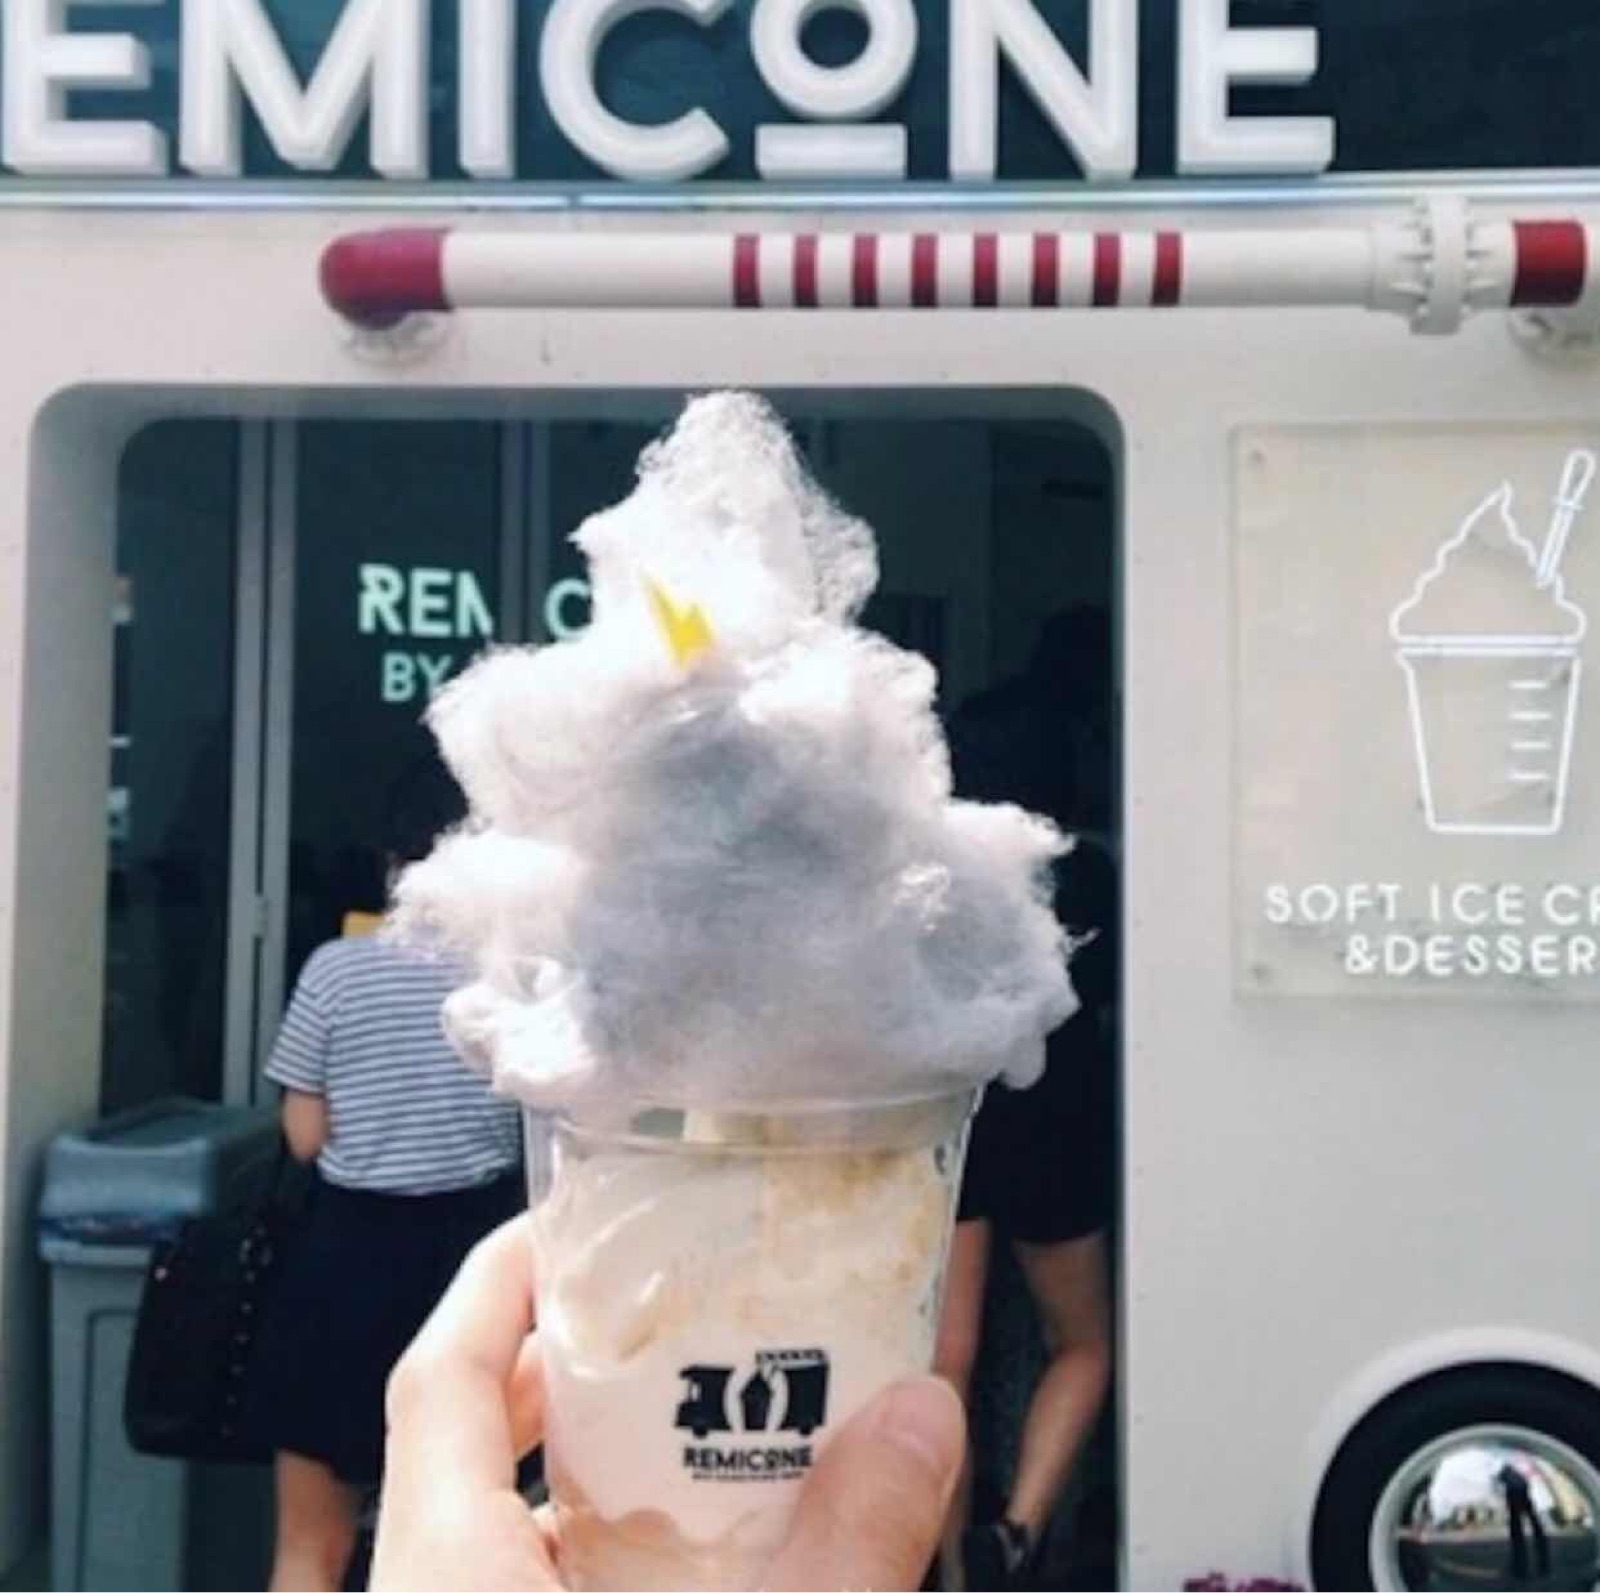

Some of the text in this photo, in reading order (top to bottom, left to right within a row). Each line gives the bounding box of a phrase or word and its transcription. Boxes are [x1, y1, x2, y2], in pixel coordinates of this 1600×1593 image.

[1264, 884, 1401, 924] SOFT
[1429, 884, 1526, 925] ICE
[683, 1446, 813, 1470] REMICONE
